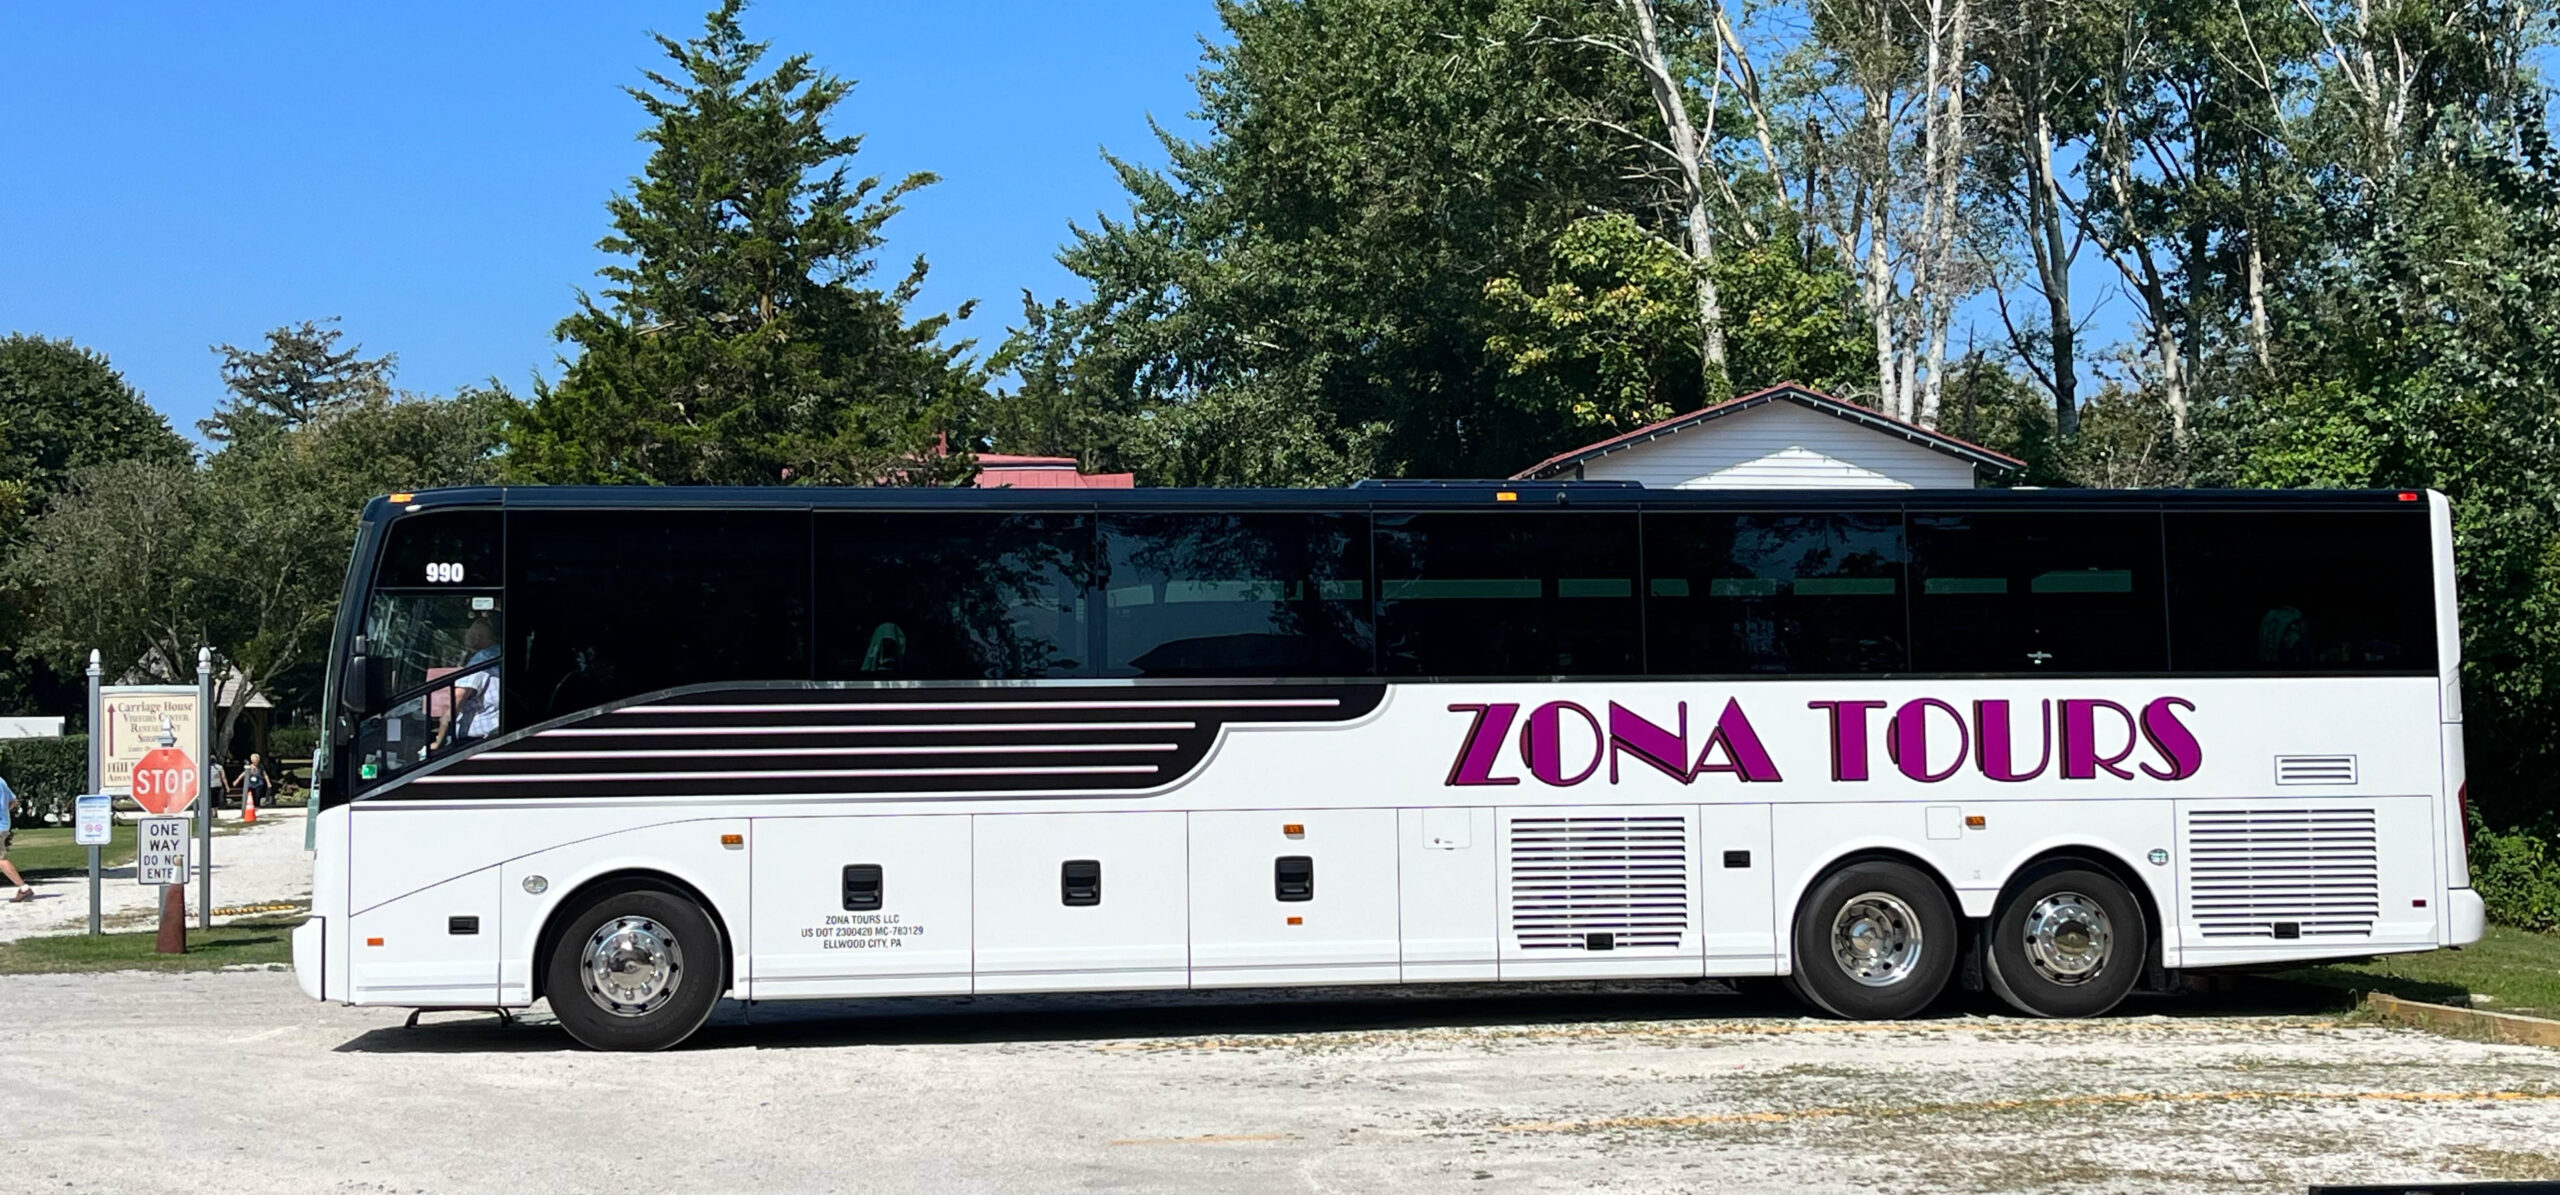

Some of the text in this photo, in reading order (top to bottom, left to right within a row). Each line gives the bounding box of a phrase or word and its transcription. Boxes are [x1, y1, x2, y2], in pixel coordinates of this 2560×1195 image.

[426, 562, 464, 582] 990
[118, 701, 193, 713] Carriage House
[1444, 696, 2202, 786] ZONA TOURS
[107, 761, 128, 773] Hill
[136, 768, 195, 795] STOP
[150, 824, 179, 836] ONE
[149, 840, 180, 851] WAY
[144, 855, 158, 866] DO
[147, 868, 174, 879] ENTE
[825, 914, 900, 925] ZONA TOURS LLC
[801, 928, 814, 937] US
[816, 927, 833, 937] DOT
[835, 926, 873, 937] 2300420
[823, 938, 902, 949] ELLWOOD CITY, PA
